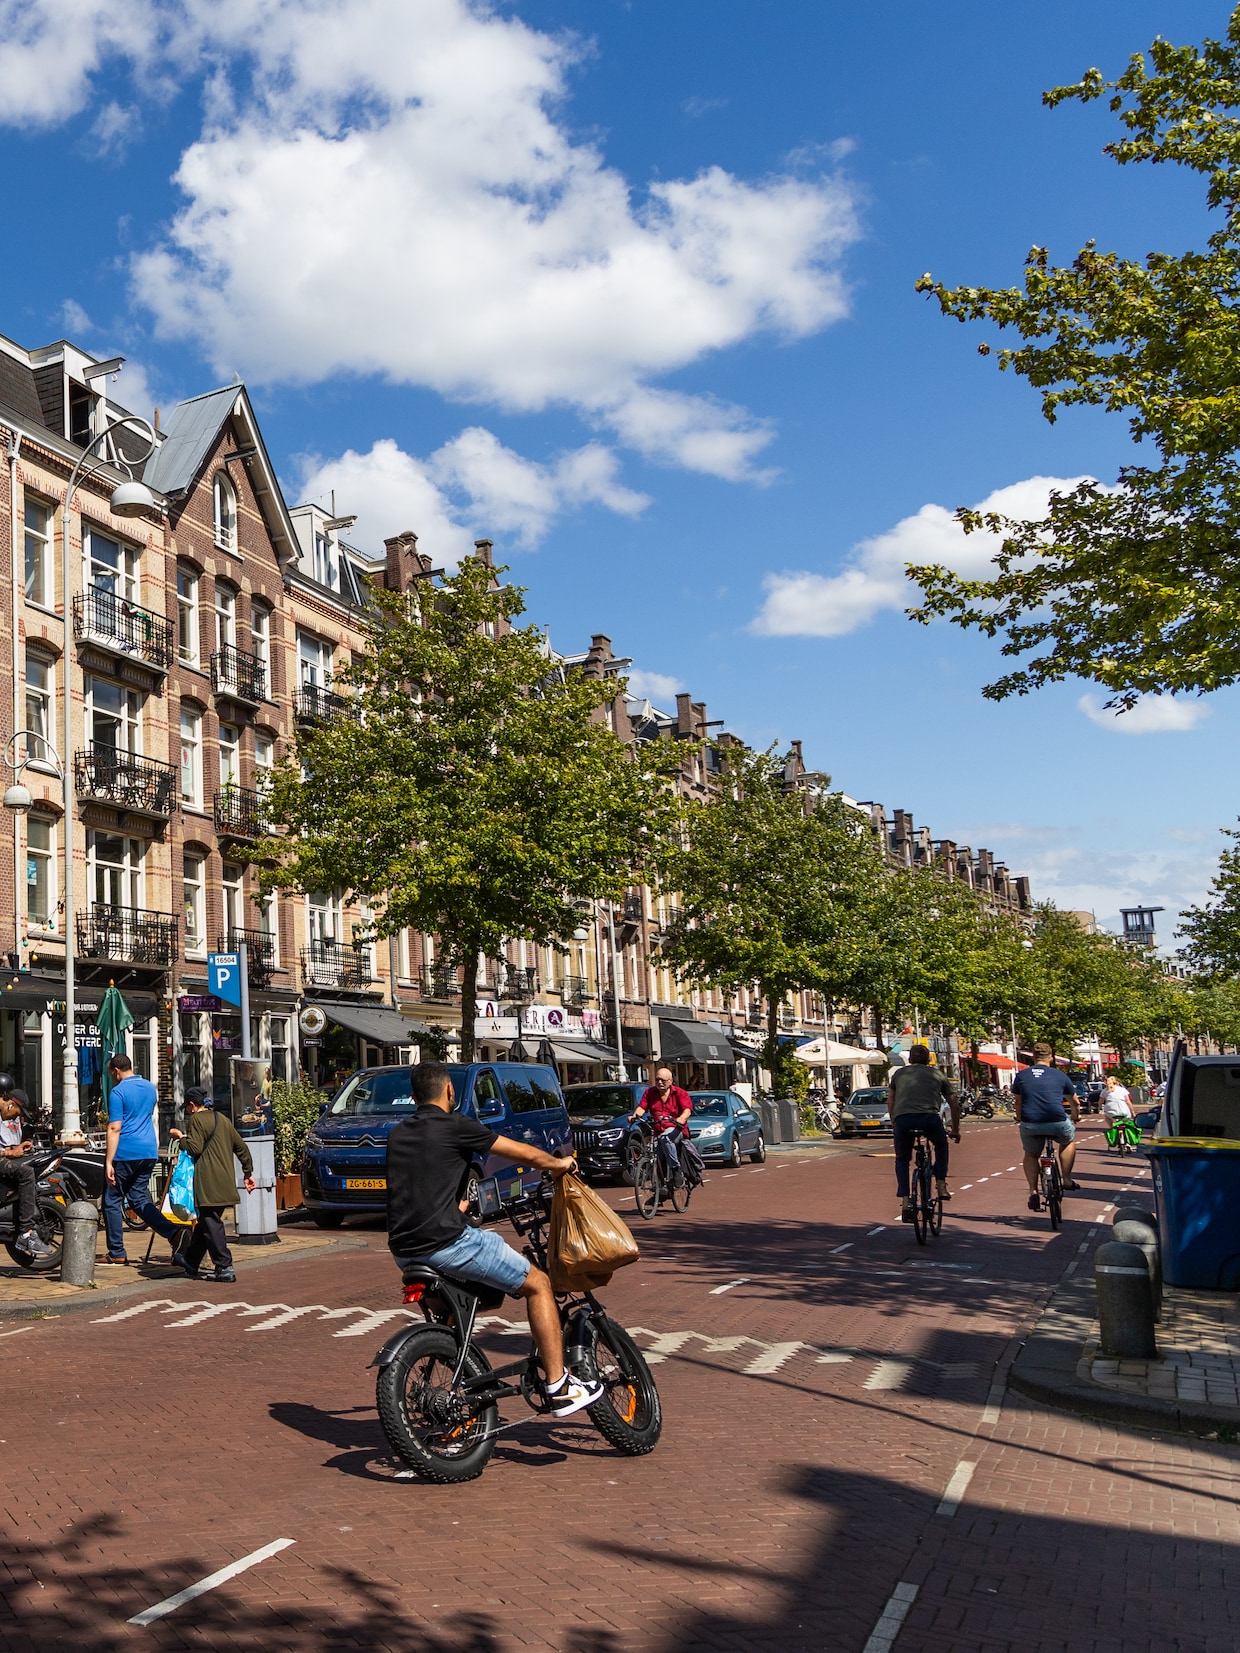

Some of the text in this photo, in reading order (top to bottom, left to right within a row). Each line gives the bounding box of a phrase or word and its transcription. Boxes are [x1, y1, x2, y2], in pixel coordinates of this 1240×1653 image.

[216, 955, 236, 965] 16504
[217, 968, 231, 989] P
[349, 1180, 384, 1188] ZG-661-S
